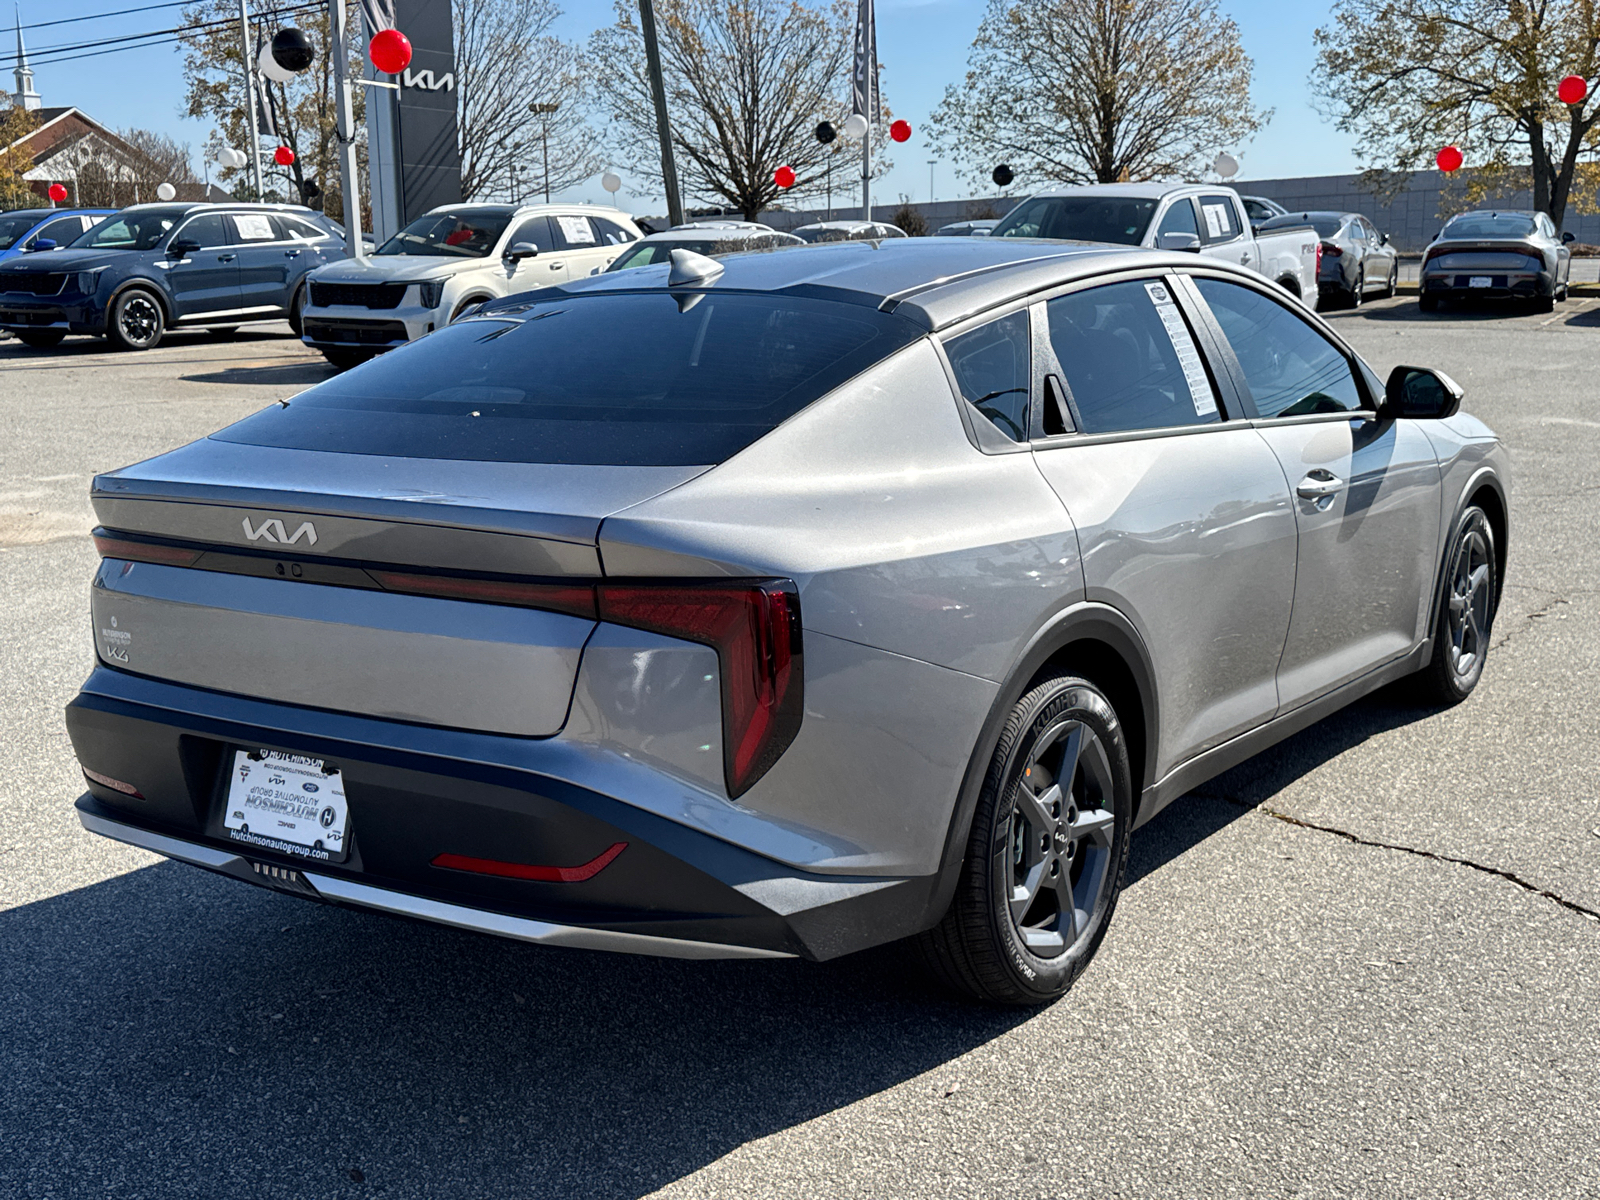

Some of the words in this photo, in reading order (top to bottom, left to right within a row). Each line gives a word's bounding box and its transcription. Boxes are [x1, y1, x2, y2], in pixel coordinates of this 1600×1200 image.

[403, 67, 454, 92] KIA
[242, 516, 319, 546] KIA
[107, 645, 129, 663] K4
[1032, 691, 1078, 739] KUMHO
[269, 750, 325, 768] HUTCHINSON
[268, 777, 285, 786] KIA
[250, 786, 273, 797] GROUP
[275, 790, 319, 806] AUTOMOTIVE
[245, 794, 319, 821] HUTCHINSON
[277, 820, 296, 829] GMC
[230, 829, 329, 860] Hutchinsonautogroup.com
